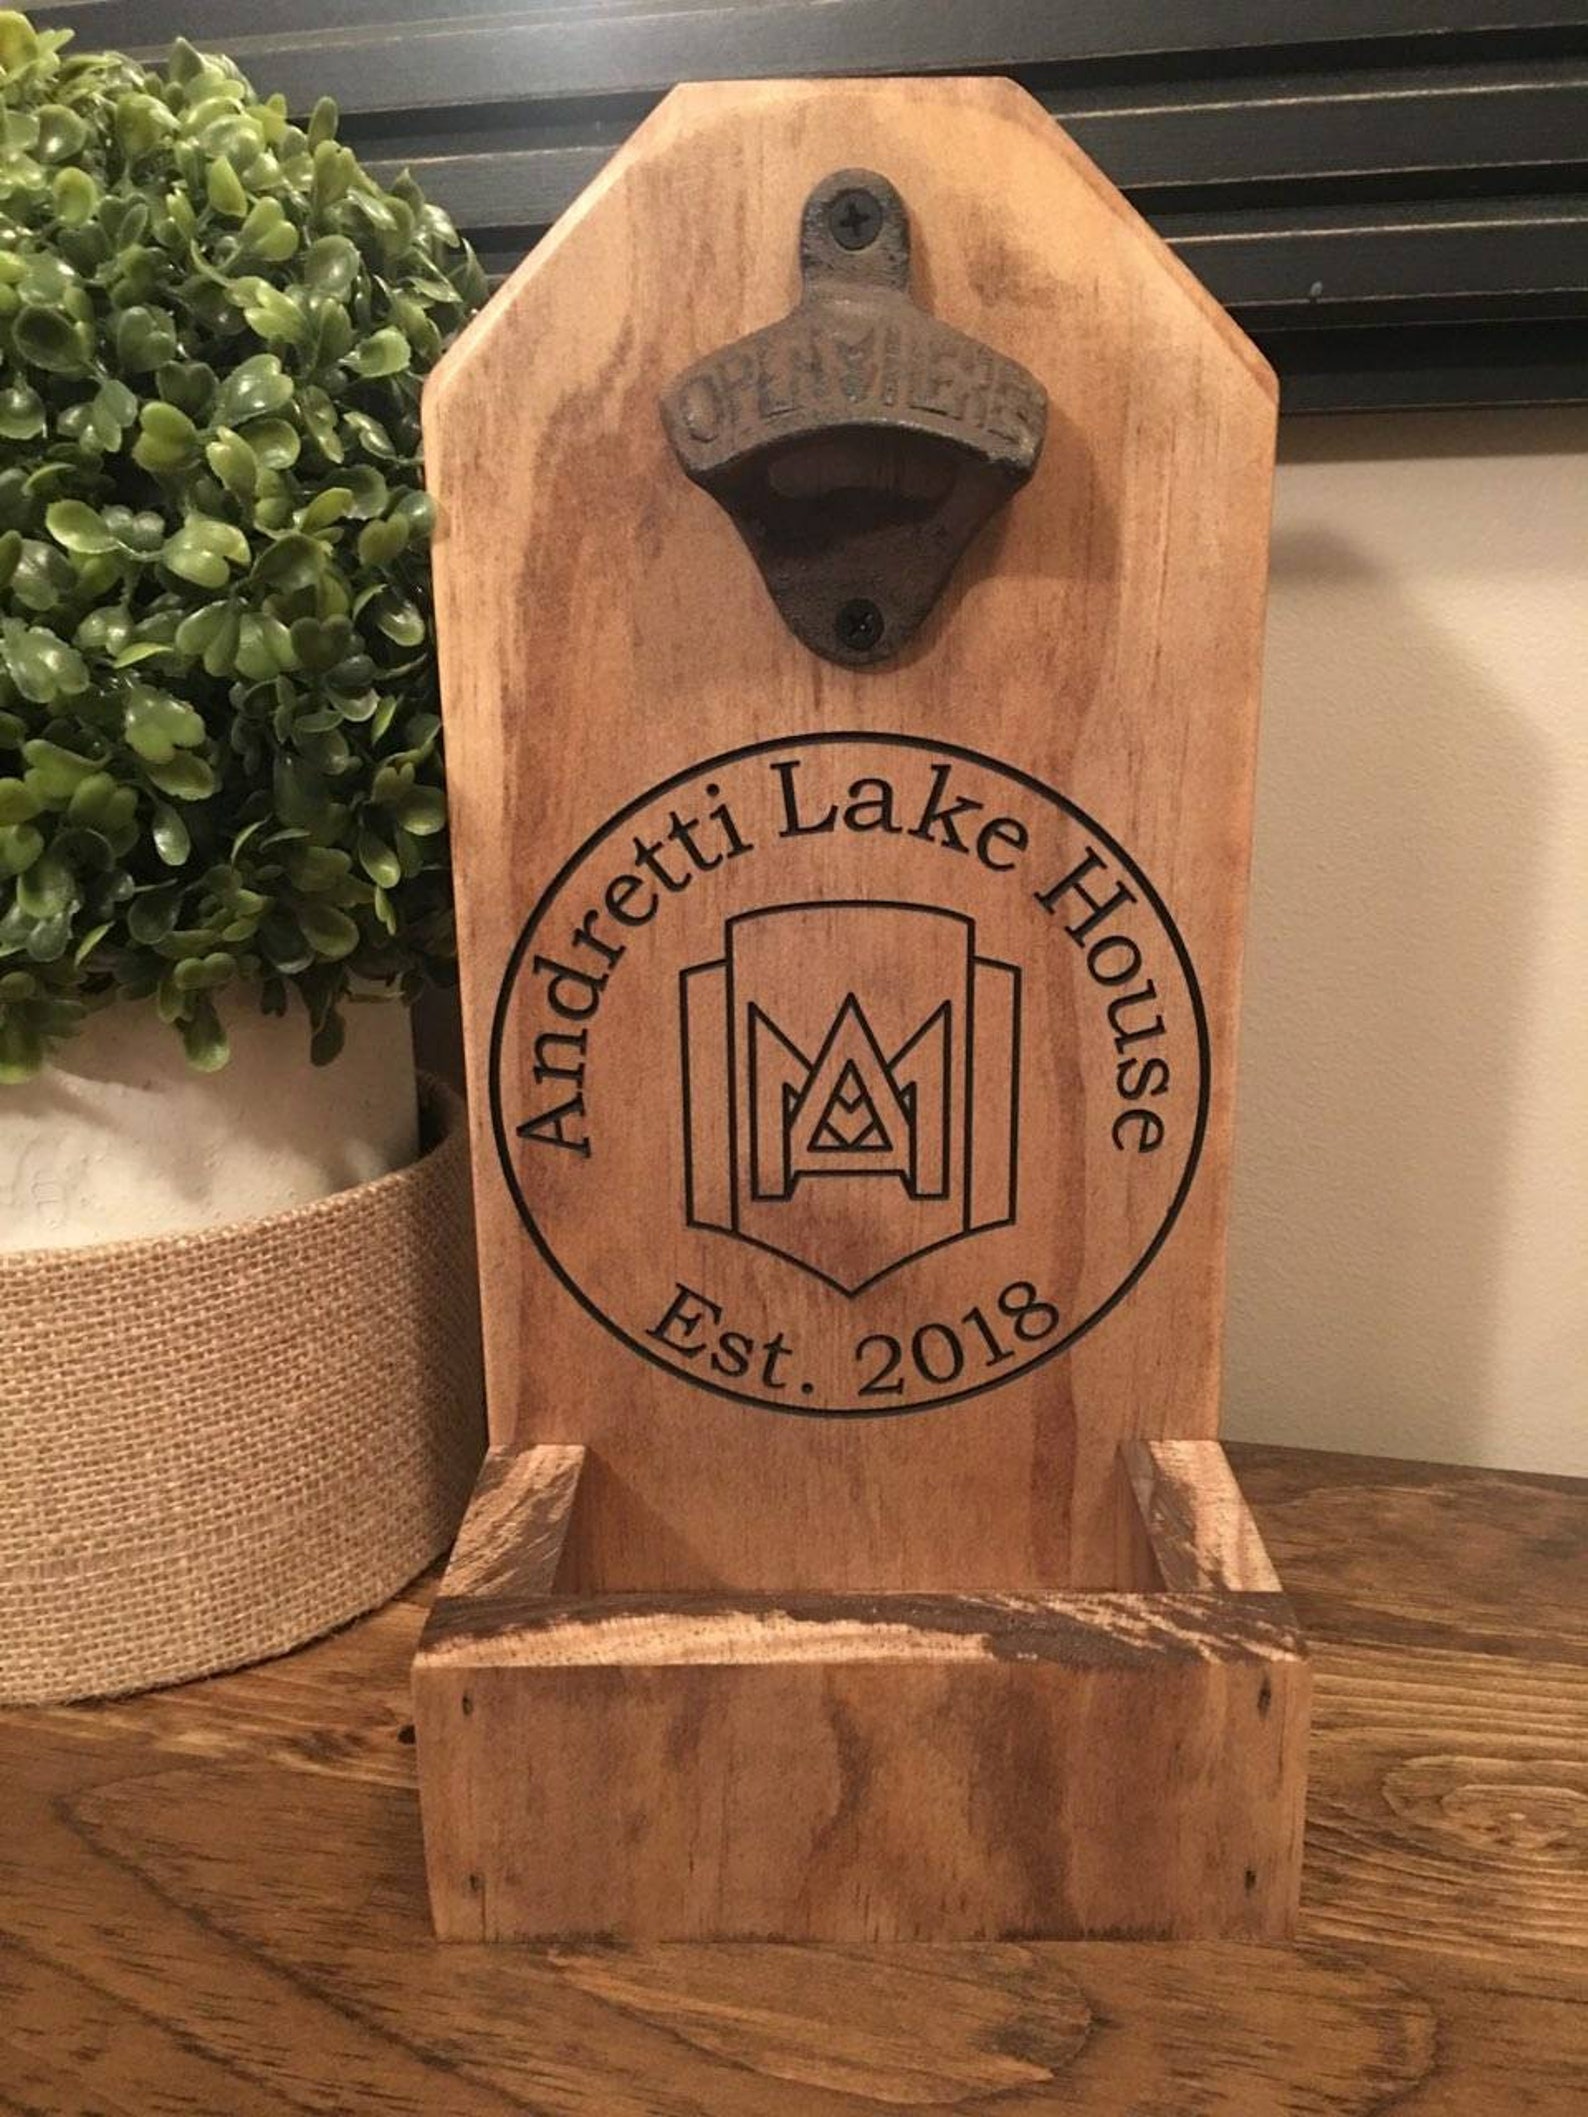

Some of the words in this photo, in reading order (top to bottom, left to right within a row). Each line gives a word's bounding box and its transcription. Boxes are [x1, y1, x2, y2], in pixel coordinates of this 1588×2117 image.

[516, 782, 754, 1160] Andretti
[769, 759, 1029, 873] Lake
[1033, 846, 1171, 1155] House
[644, 1282, 815, 1396] Est.
[854, 1280, 1060, 1397] 2018
